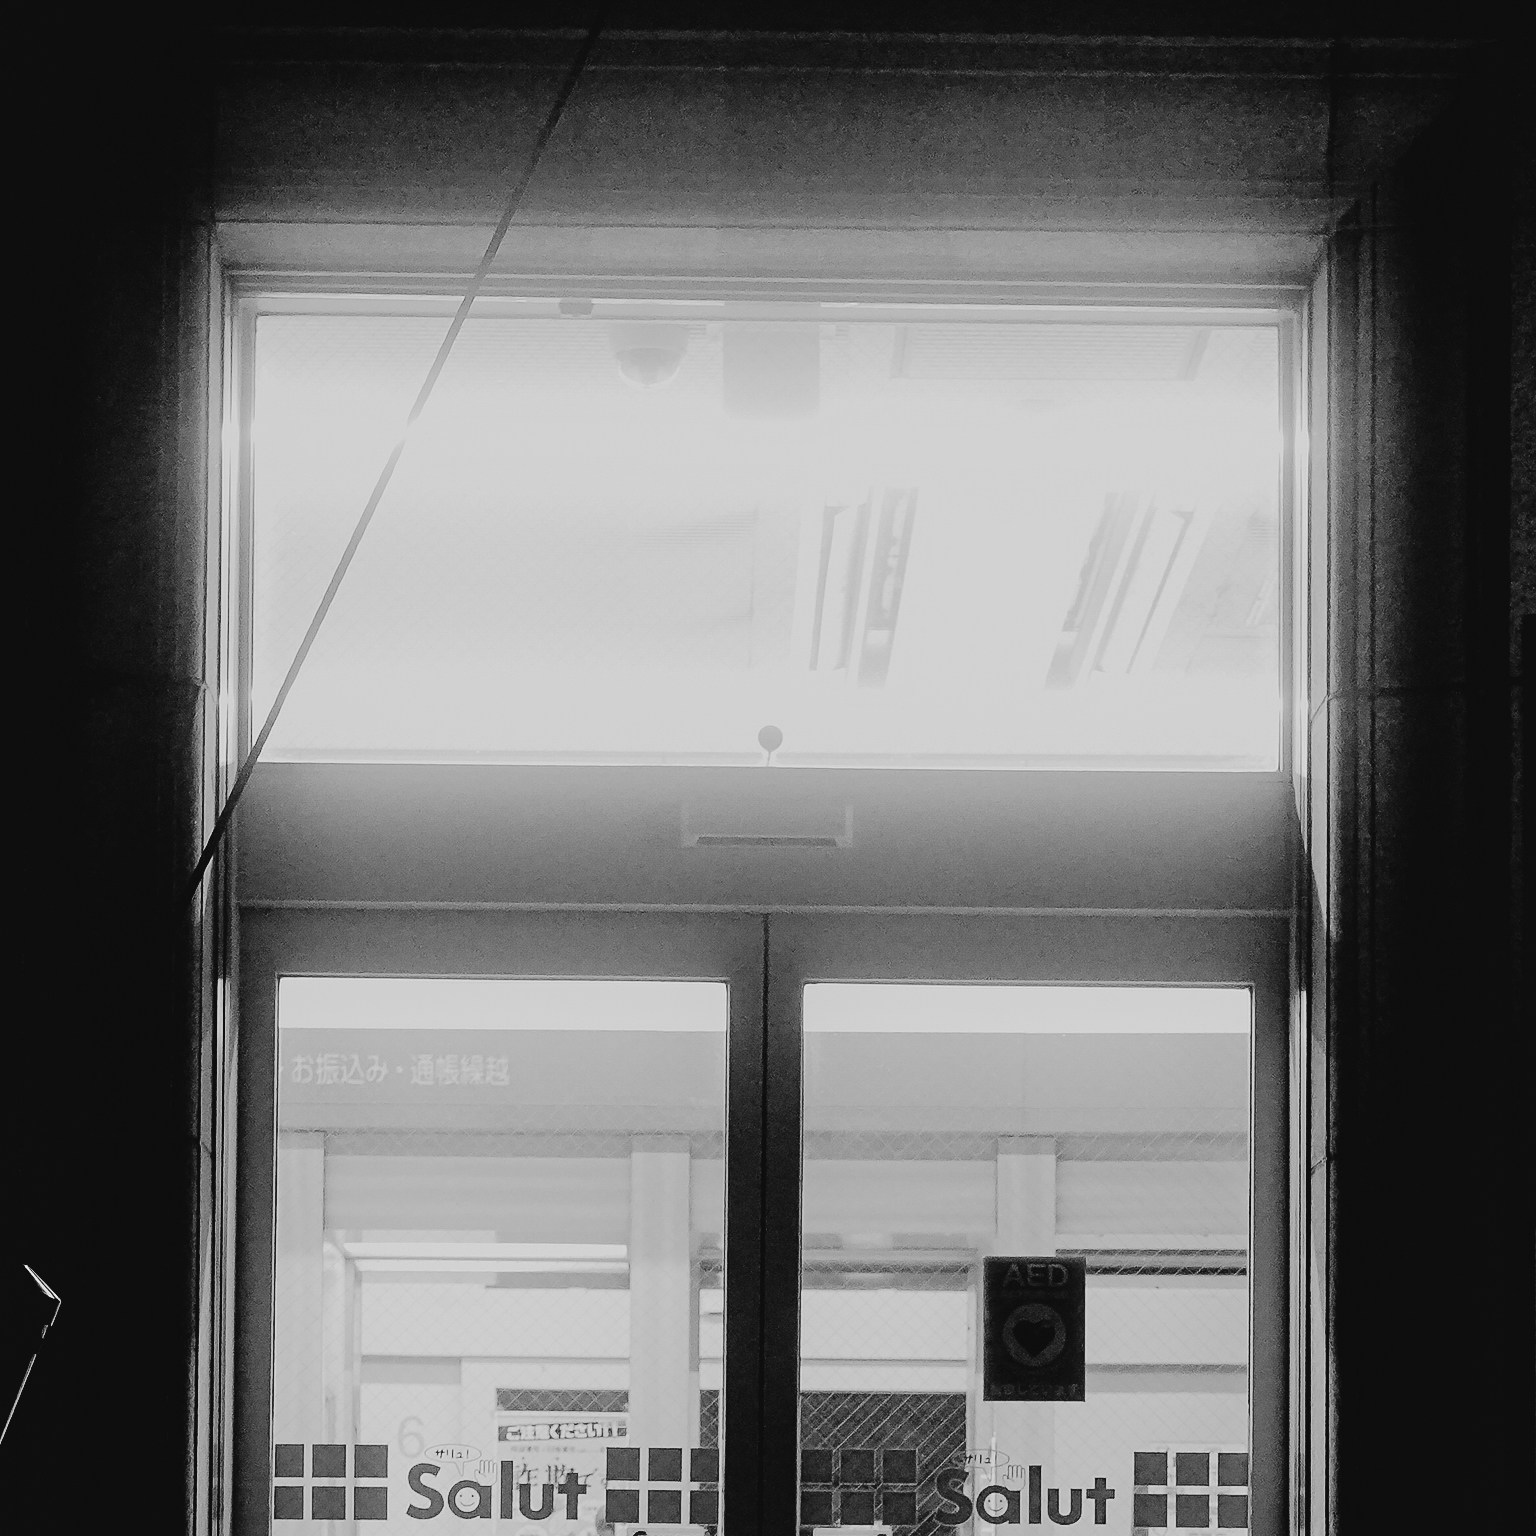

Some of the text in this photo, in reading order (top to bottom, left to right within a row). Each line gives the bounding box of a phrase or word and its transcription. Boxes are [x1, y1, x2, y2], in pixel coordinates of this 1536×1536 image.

[1002, 1263, 1069, 1287] AED
[406, 1460, 587, 1520] Salut
[935, 1465, 1115, 1526] Salut
